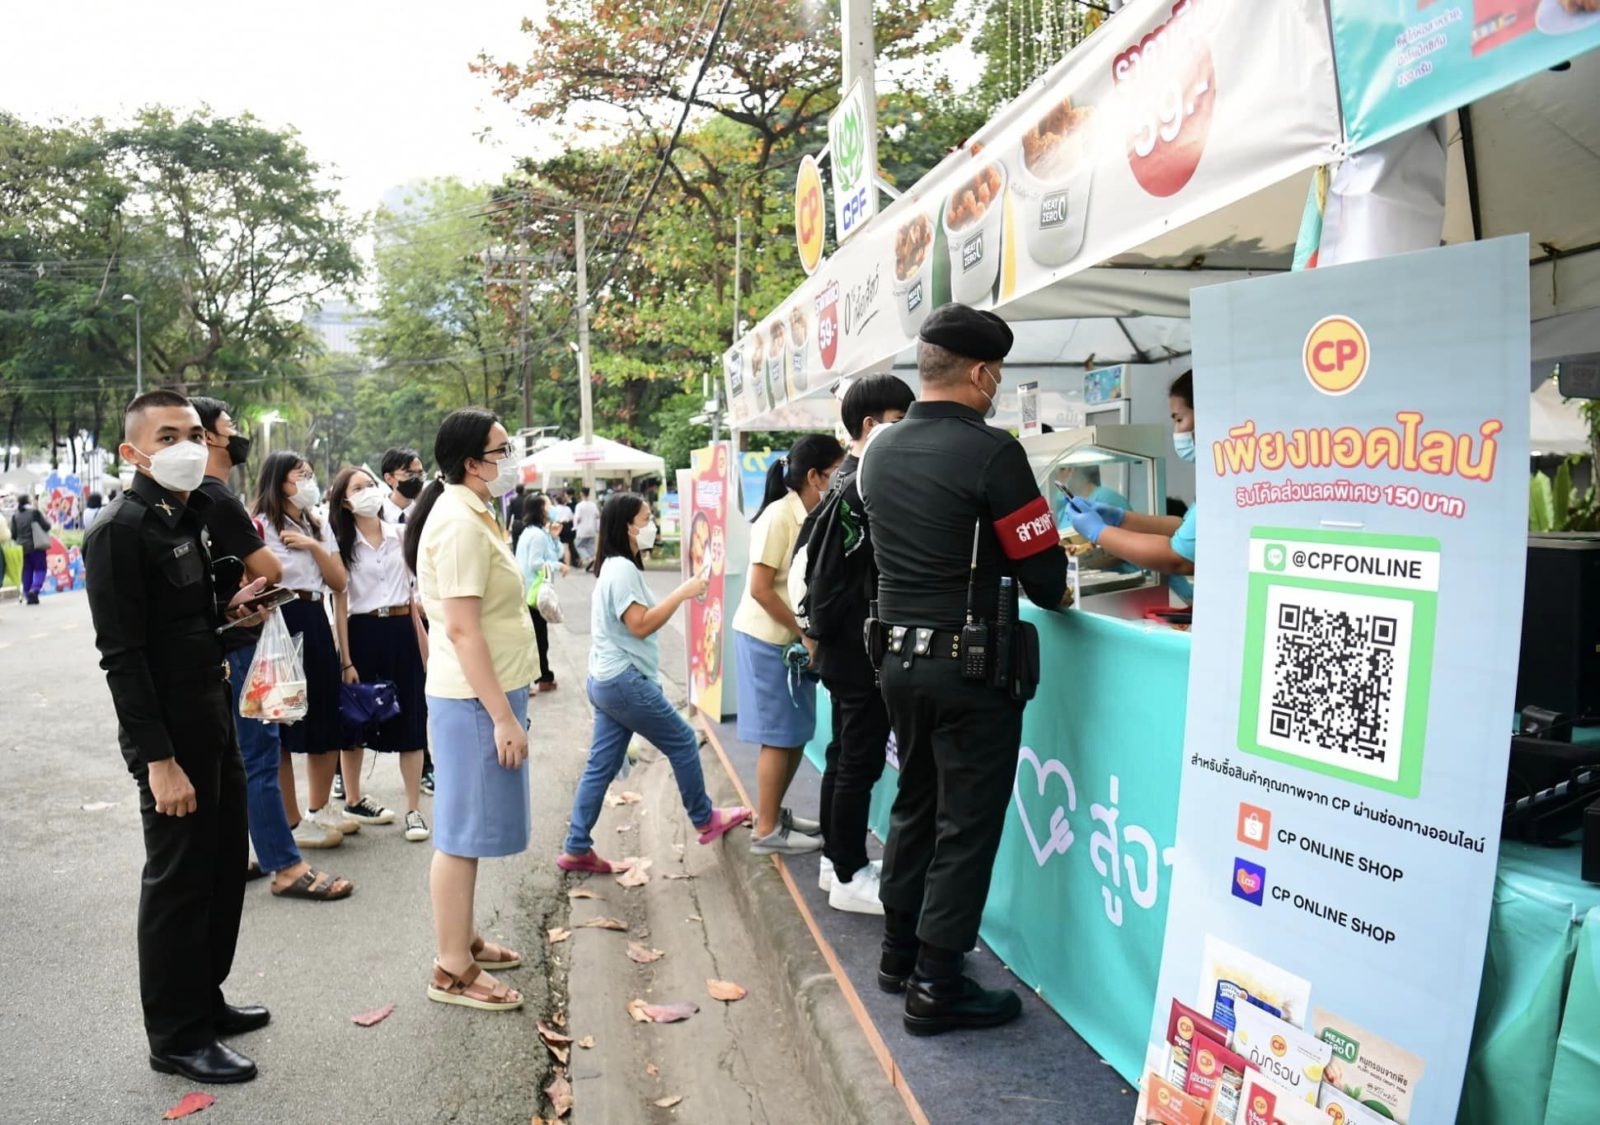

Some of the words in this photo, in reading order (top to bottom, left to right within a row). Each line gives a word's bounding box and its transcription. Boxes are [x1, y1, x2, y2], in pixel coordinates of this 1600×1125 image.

[799, 187, 818, 245] CP
[842, 186, 867, 231] CPF
[1041, 210, 1058, 223] ZERO
[1042, 197, 1058, 211] MEAT
[1311, 338, 1359, 373] CP
[1212, 410, 1503, 482] เพียงแอดไลน์
[1236, 480, 1380, 507] รับโค้ดส่วนลดพิเศษ
[1383, 485, 1421, 509] 150
[1422, 494, 1465, 518] บาท
[1291, 549, 1423, 580] @CPFONLINE
[1190, 752, 1329, 806] สำหรับซื้อสินค้าคุณภาพจาก
[1331, 796, 1351, 811] CP
[1353, 801, 1486, 853] ผ่านช่องทางออนไลน์
[1089, 774, 1176, 928] สู่อ
[1277, 829, 1297, 845] CP
[1299, 836, 1355, 867] ONLINE
[1357, 856, 1404, 882] SHOP
[1271, 885, 1291, 902] CP
[1293, 894, 1348, 927] ONLINE
[1350, 917, 1396, 944] SHOP
[1324, 1031, 1346, 1046] MEAT
[1325, 1040, 1345, 1055] RO
